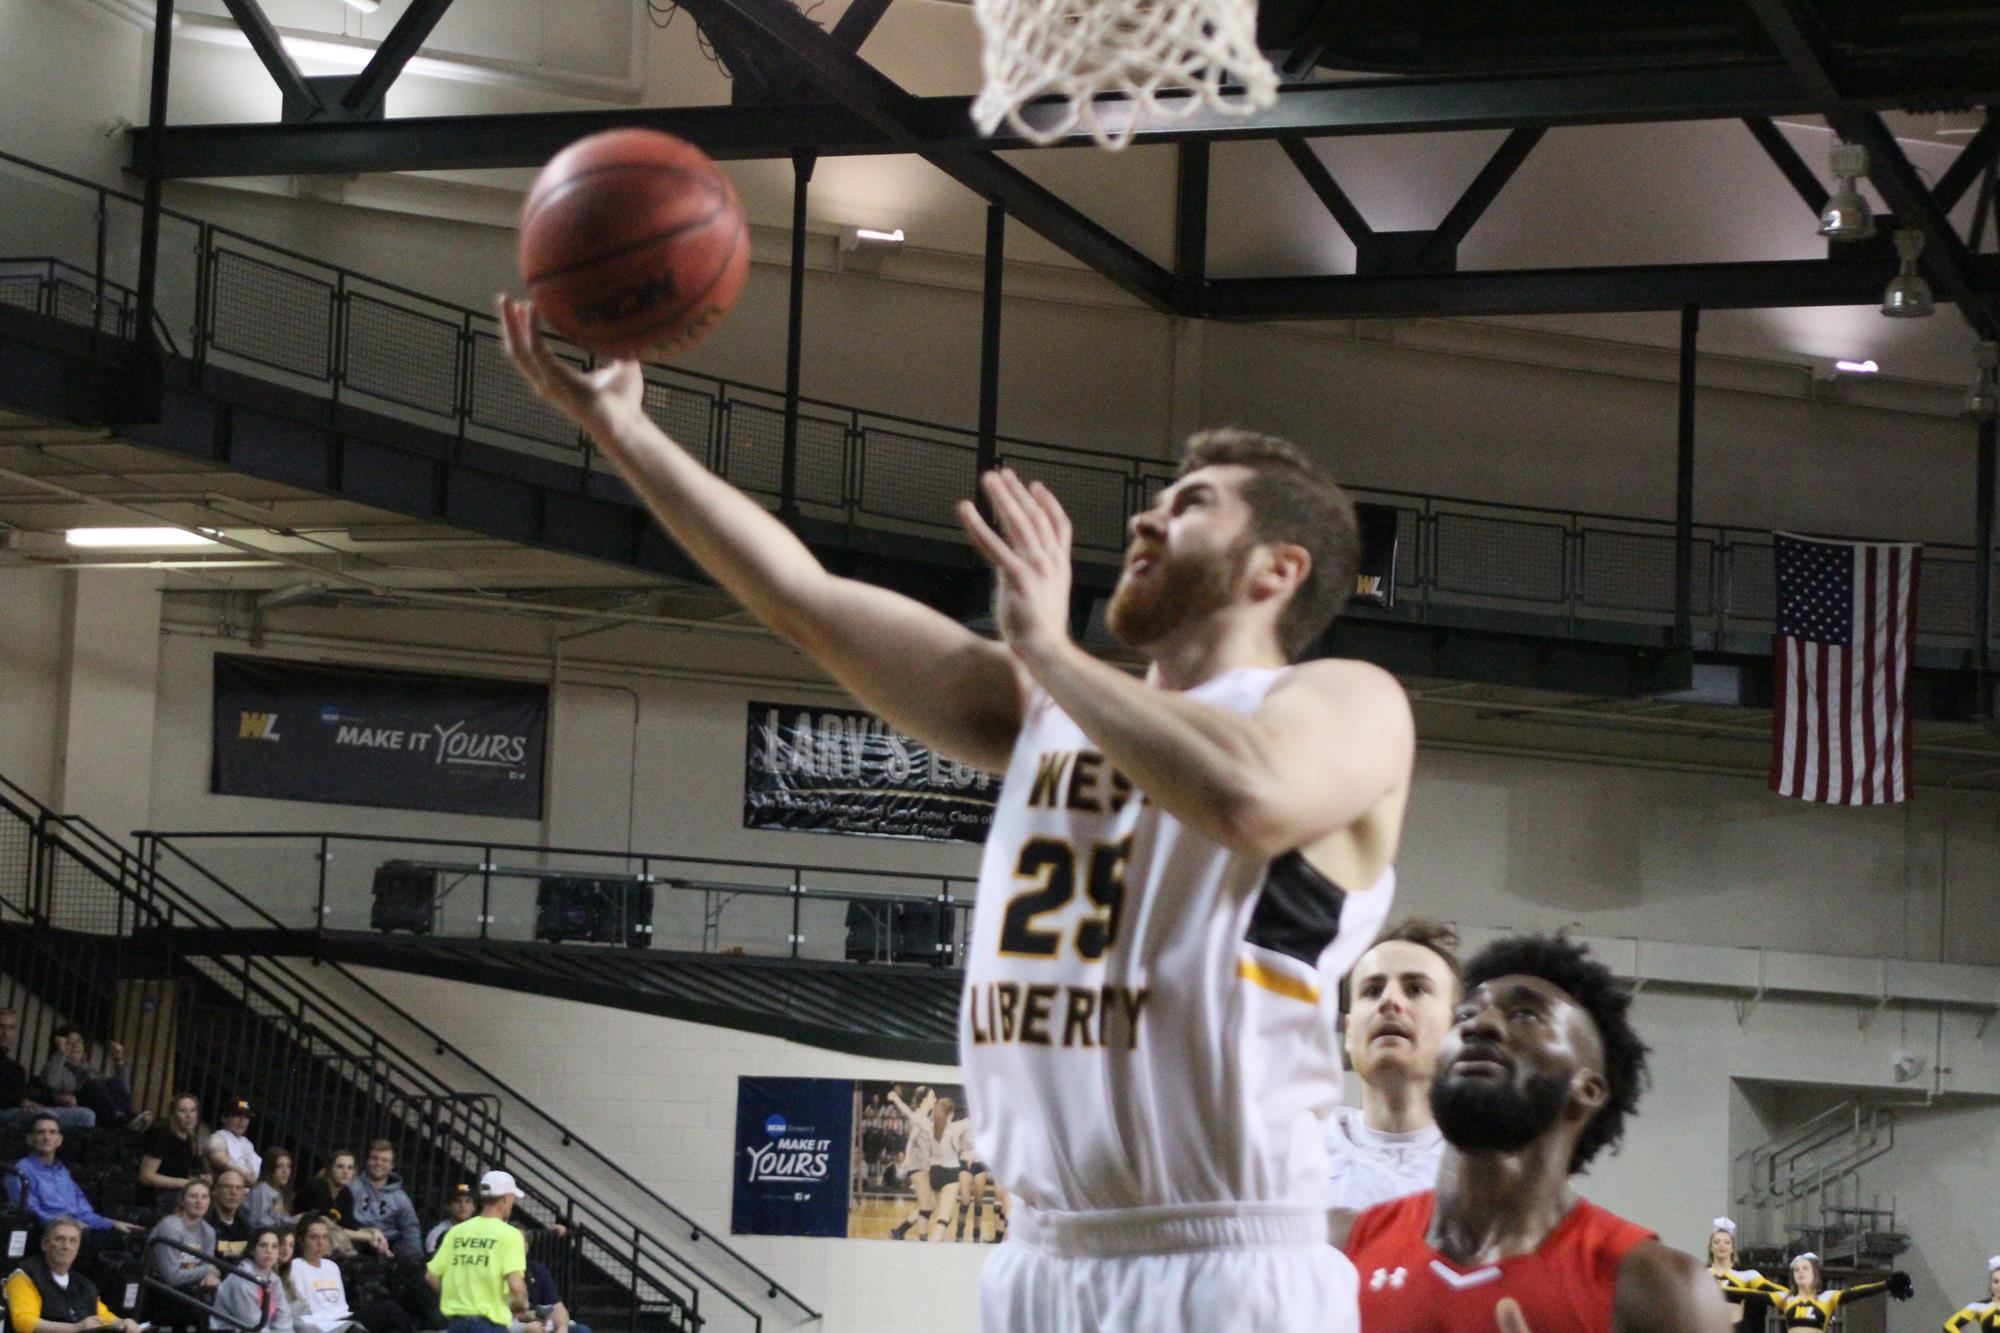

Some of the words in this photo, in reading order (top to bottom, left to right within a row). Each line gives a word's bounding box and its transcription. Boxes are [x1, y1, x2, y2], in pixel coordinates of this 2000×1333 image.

[239, 711, 280, 741] WL
[336, 726, 404, 750] MAKE
[407, 732, 432, 751] IT
[434, 720, 527, 765] YOURS
[950, 811, 979, 824] Class
[778, 1138, 816, 1151] MAKE
[817, 1138, 832, 1151] IT
[746, 1141, 829, 1183] YOURS
[454, 1237, 498, 1249] EVENT
